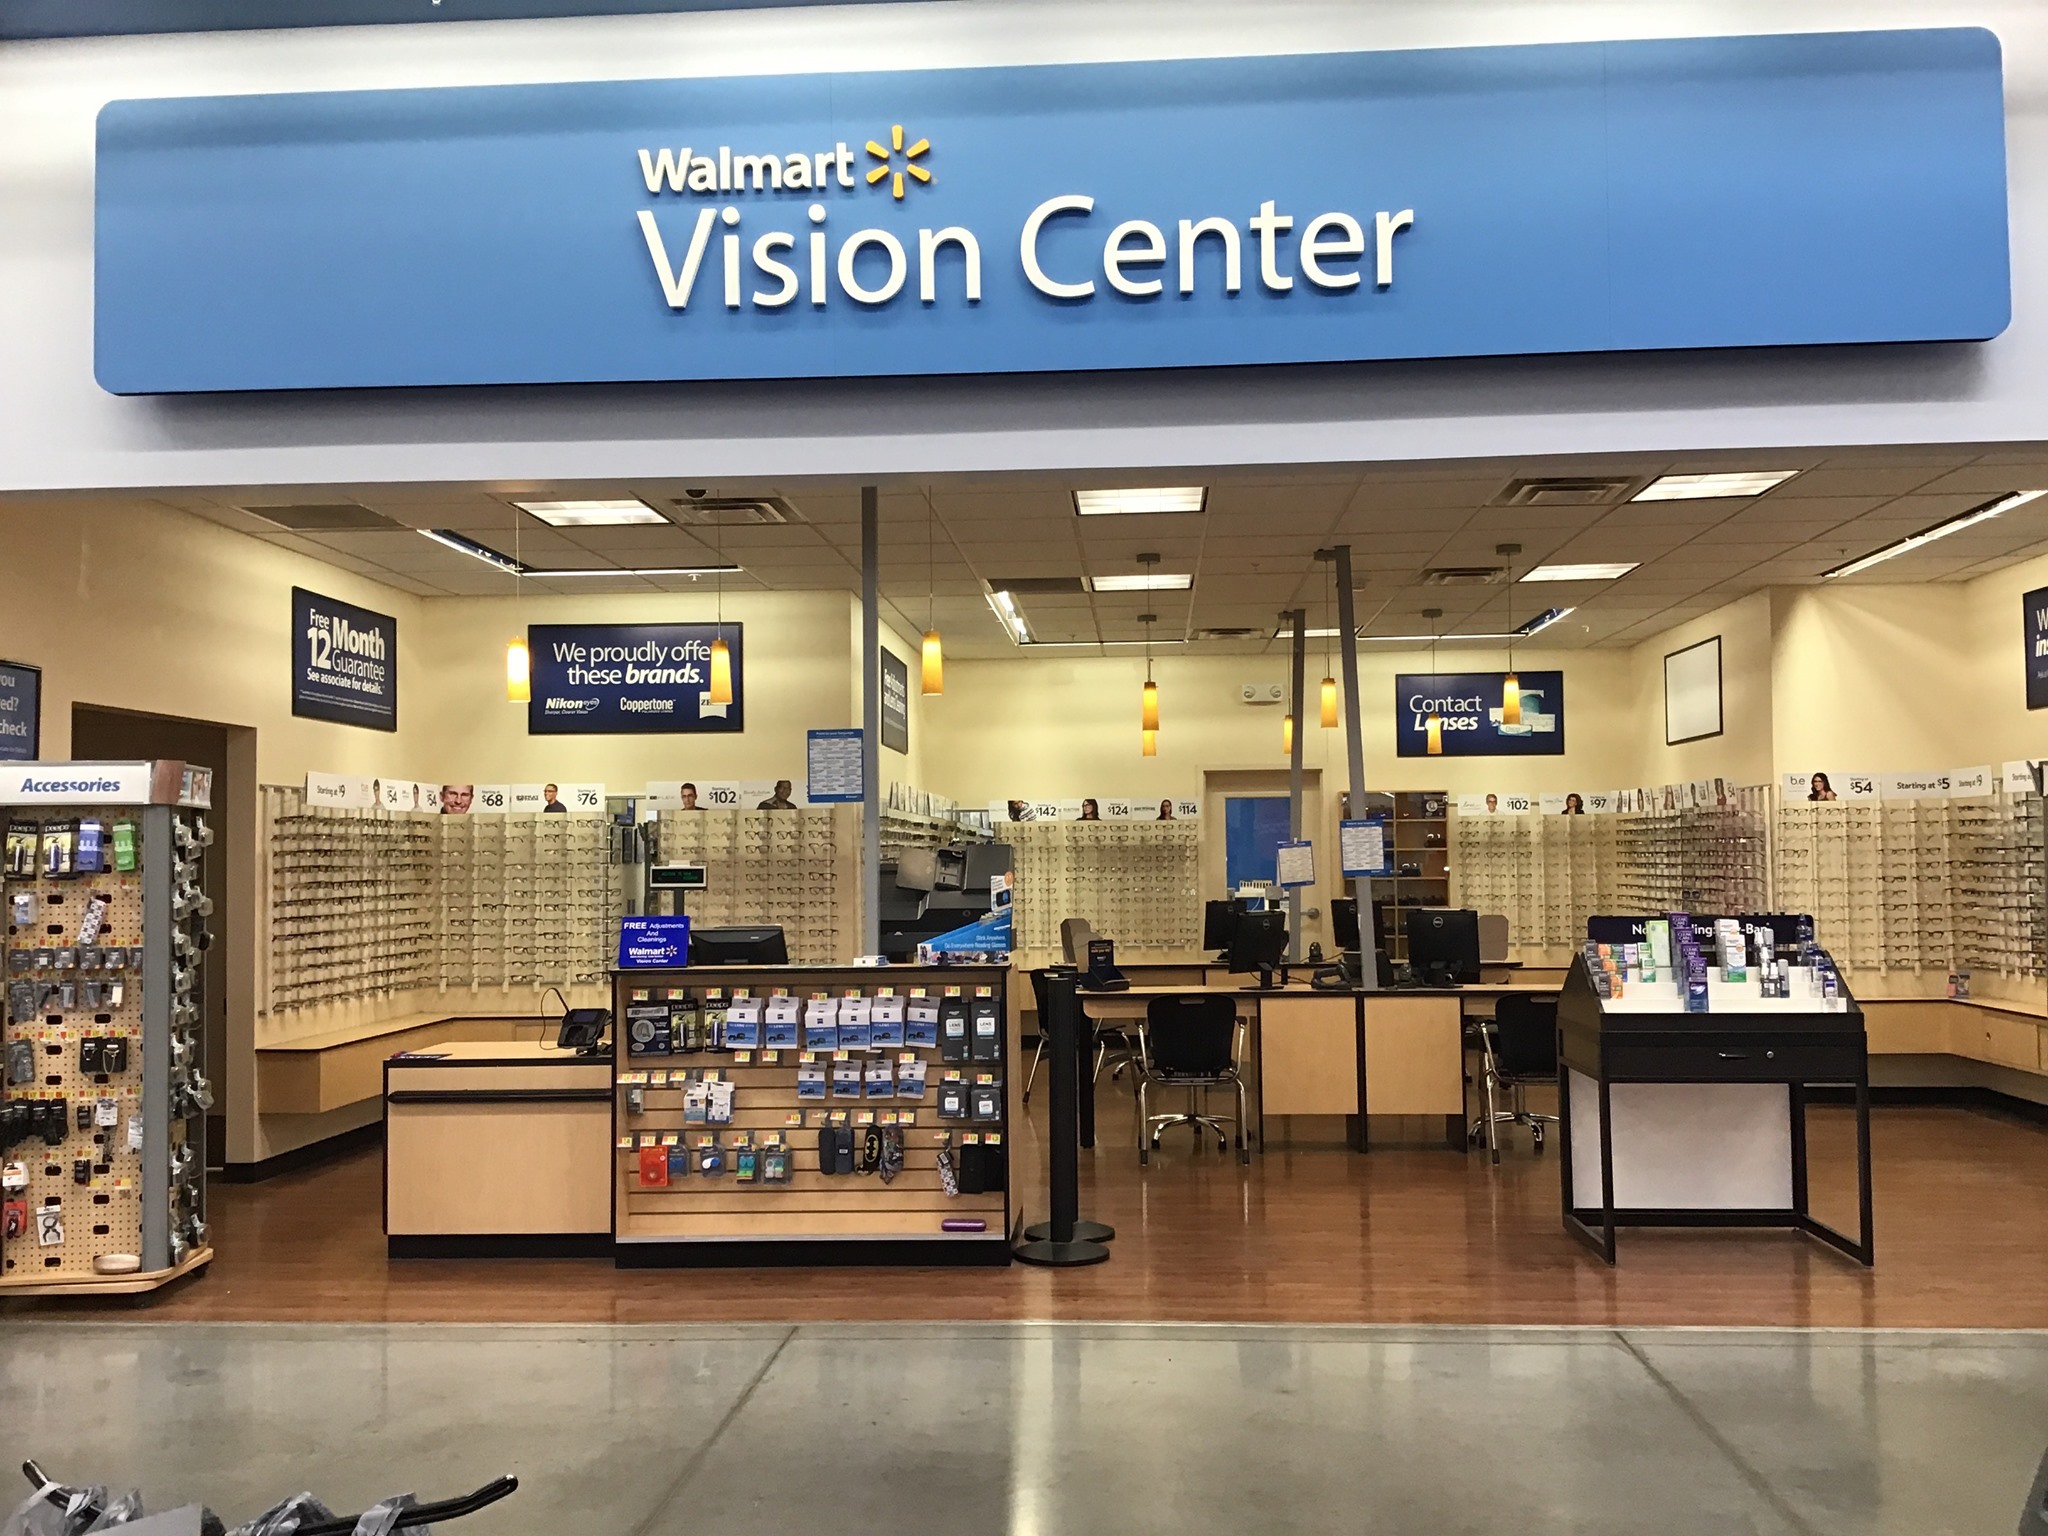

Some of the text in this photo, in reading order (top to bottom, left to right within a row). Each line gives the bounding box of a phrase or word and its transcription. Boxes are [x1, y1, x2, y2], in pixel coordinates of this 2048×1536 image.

[637, 142, 855, 193] Walmart
[637, 195, 1414, 309] Vision Center
[310, 608, 330, 630] Free
[307, 616, 385, 670] 12 Month
[552, 640, 711, 667] We proudly offe
[332, 649, 385, 682] Guarantee
[566, 663, 704, 685] these brands.
[0, 675, 15, 687] ou
[307, 667, 383, 695] See associate for details.
[0, 696, 19, 711] ed?
[545, 697, 583, 710] Nikon
[620, 697, 674, 713] Coppertone
[1409, 694, 1483, 713] Contact
[21, 777, 120, 793] Accessories
[338, 784, 346, 798] $9
[1850, 782, 1873, 794] $54
[1897, 782, 1926, 791] Starting
[1937, 778, 1950, 790] $5
[481, 793, 504, 807] $68
[577, 793, 598, 806] $76
[708, 790, 737, 804] $102
[1590, 798, 1607, 809] $97
[1035, 806, 1057, 817] $142
[1107, 805, 1128, 816] $124
[1178, 804, 1198, 815] $114
[1506, 800, 1529, 810] $102
[9, 824, 37, 833] peeps
[45, 824, 70, 833] peeps
[624, 921, 647, 930] FREE
[1632, 923, 1648, 935] No
[637, 936, 667, 944] Cleanings
[628, 947, 666, 956] Walmart
